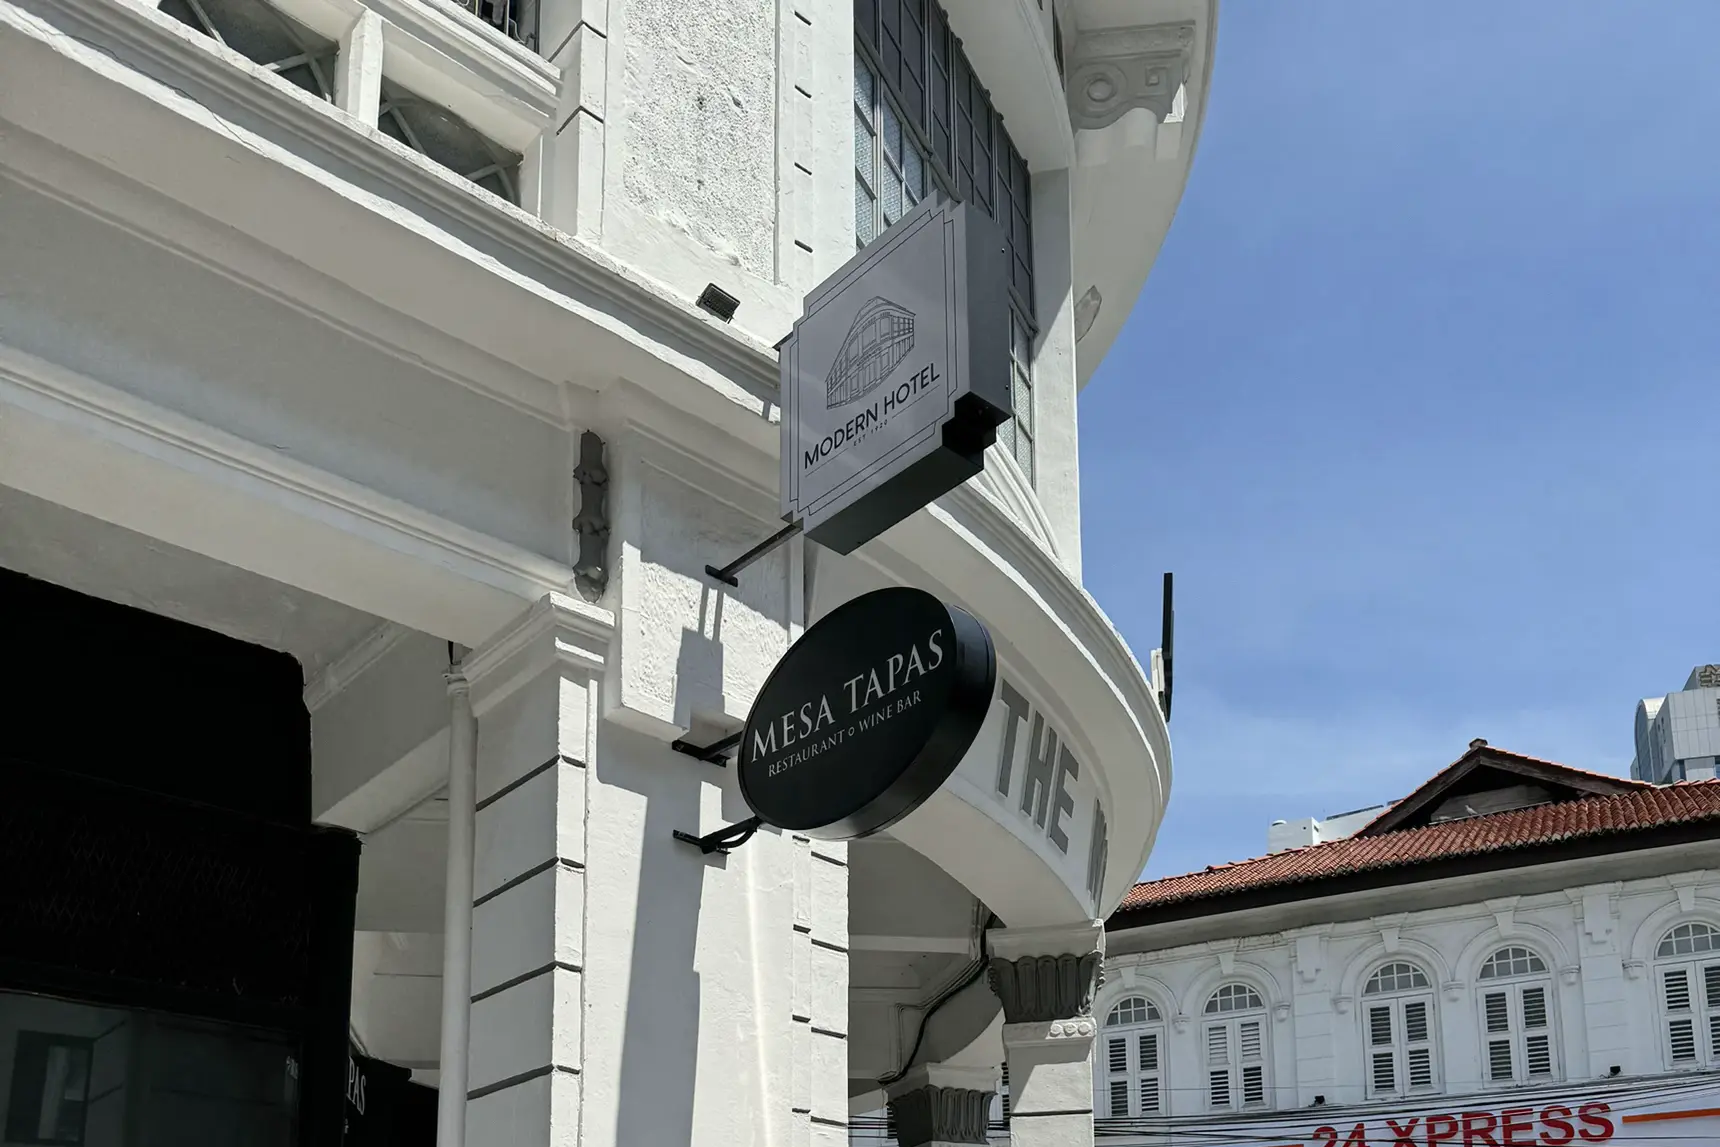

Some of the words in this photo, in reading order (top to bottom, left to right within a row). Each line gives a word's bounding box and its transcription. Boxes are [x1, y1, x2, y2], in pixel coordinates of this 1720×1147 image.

[804, 402, 878, 469] MODERN
[884, 363, 940, 415] HOTEL
[751, 694, 836, 763] MESA
[843, 629, 943, 714] TAPAS
[768, 729, 845, 777] RESTAURANT
[858, 704, 893, 732] WINE
[896, 690, 921, 714] BAR
[998, 678, 1079, 855] THE
